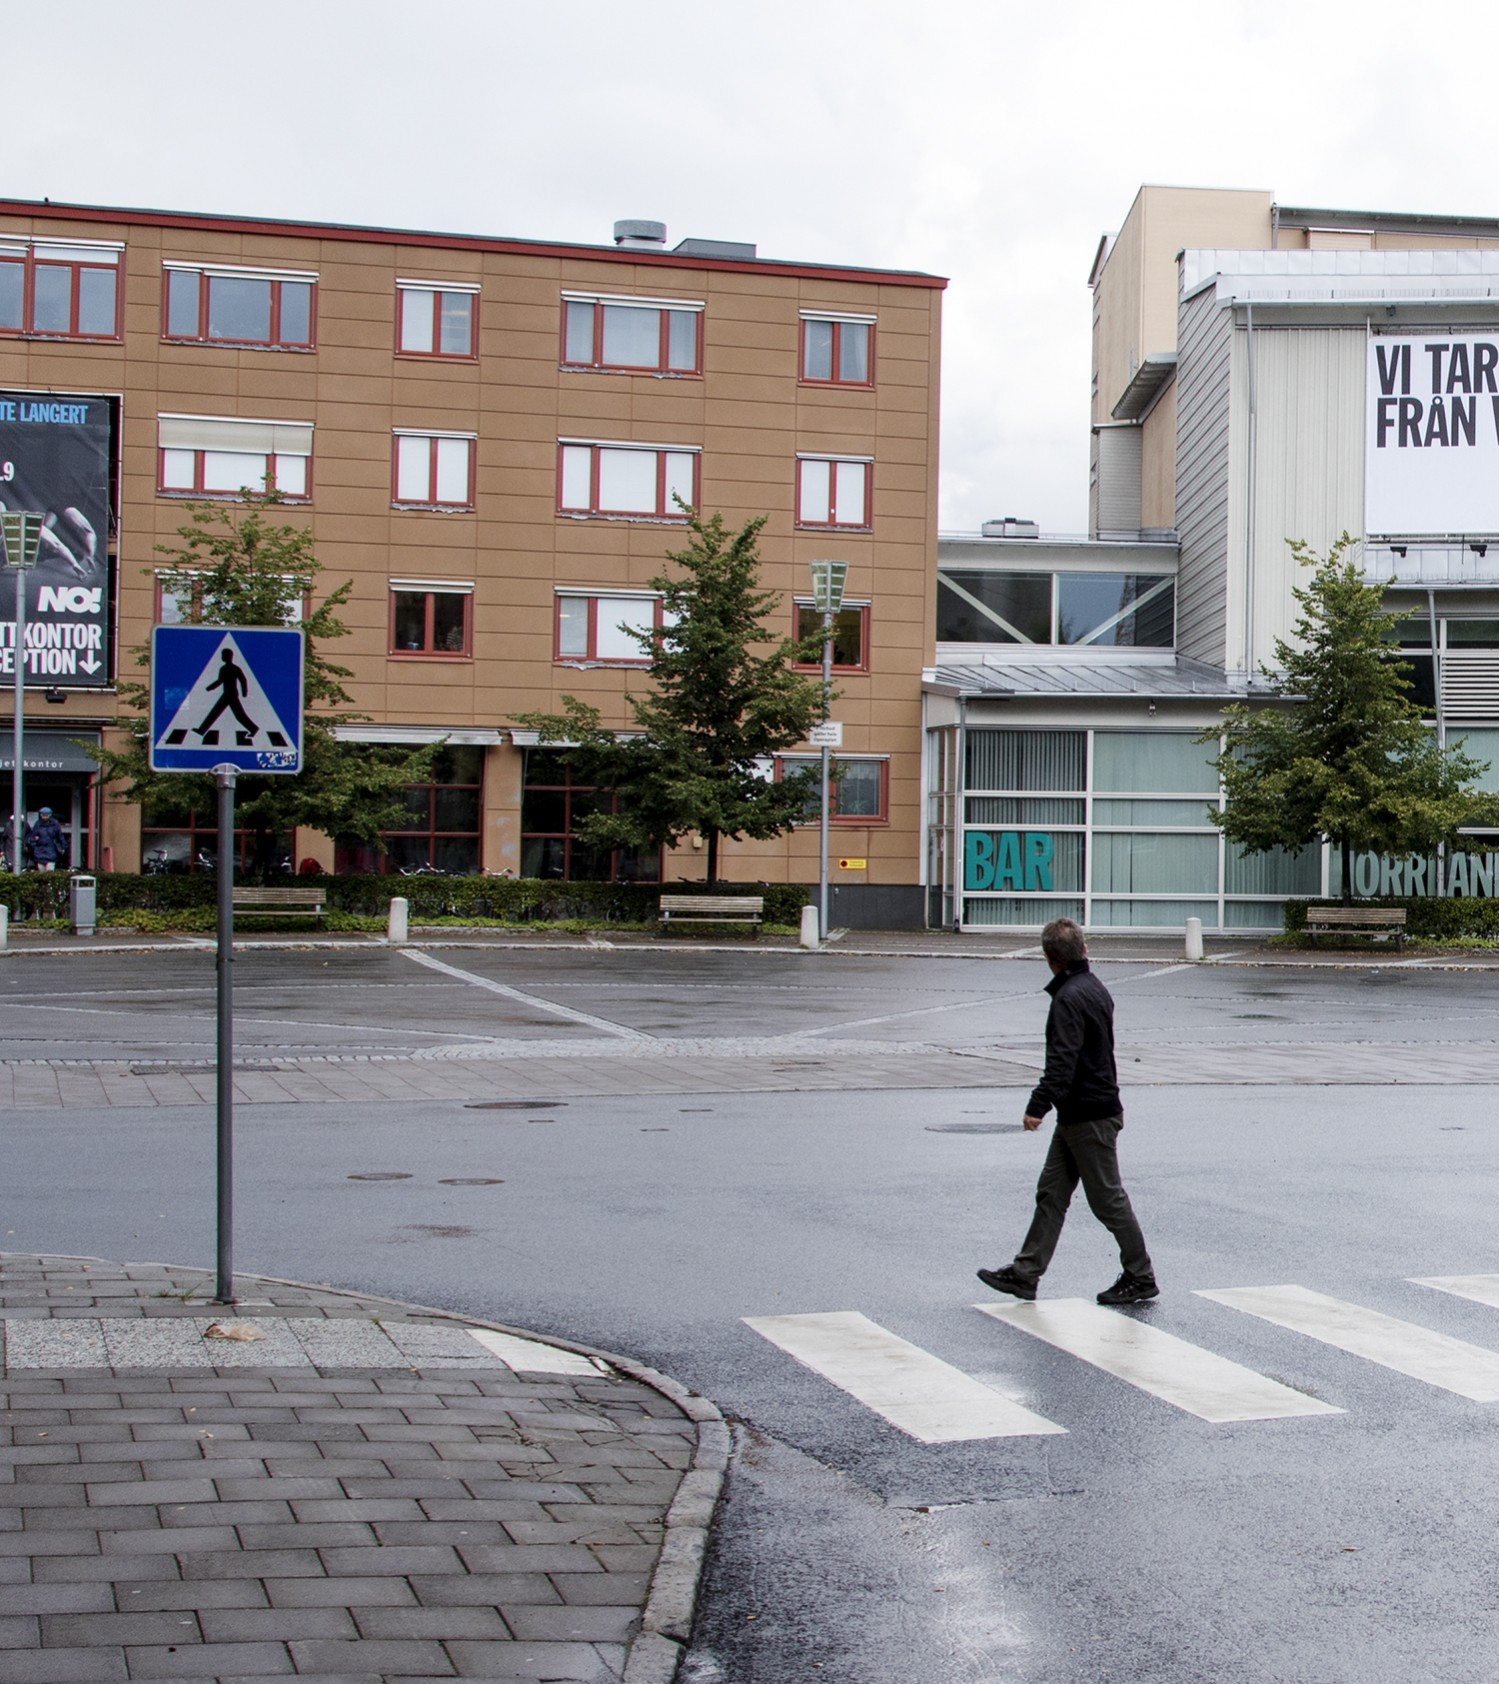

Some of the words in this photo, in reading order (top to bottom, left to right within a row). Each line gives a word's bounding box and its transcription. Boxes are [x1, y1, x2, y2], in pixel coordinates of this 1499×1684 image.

[1375, 344, 1411, 395] VI
[1425, 342, 1499, 394] TAR
[20, 402, 88, 424] LANGERT
[1376, 395, 1477, 448] FRÅN
[38, 586, 103, 614] NO!
[0, 648, 76, 675] EPTION
[965, 831, 1055, 891] BAR
